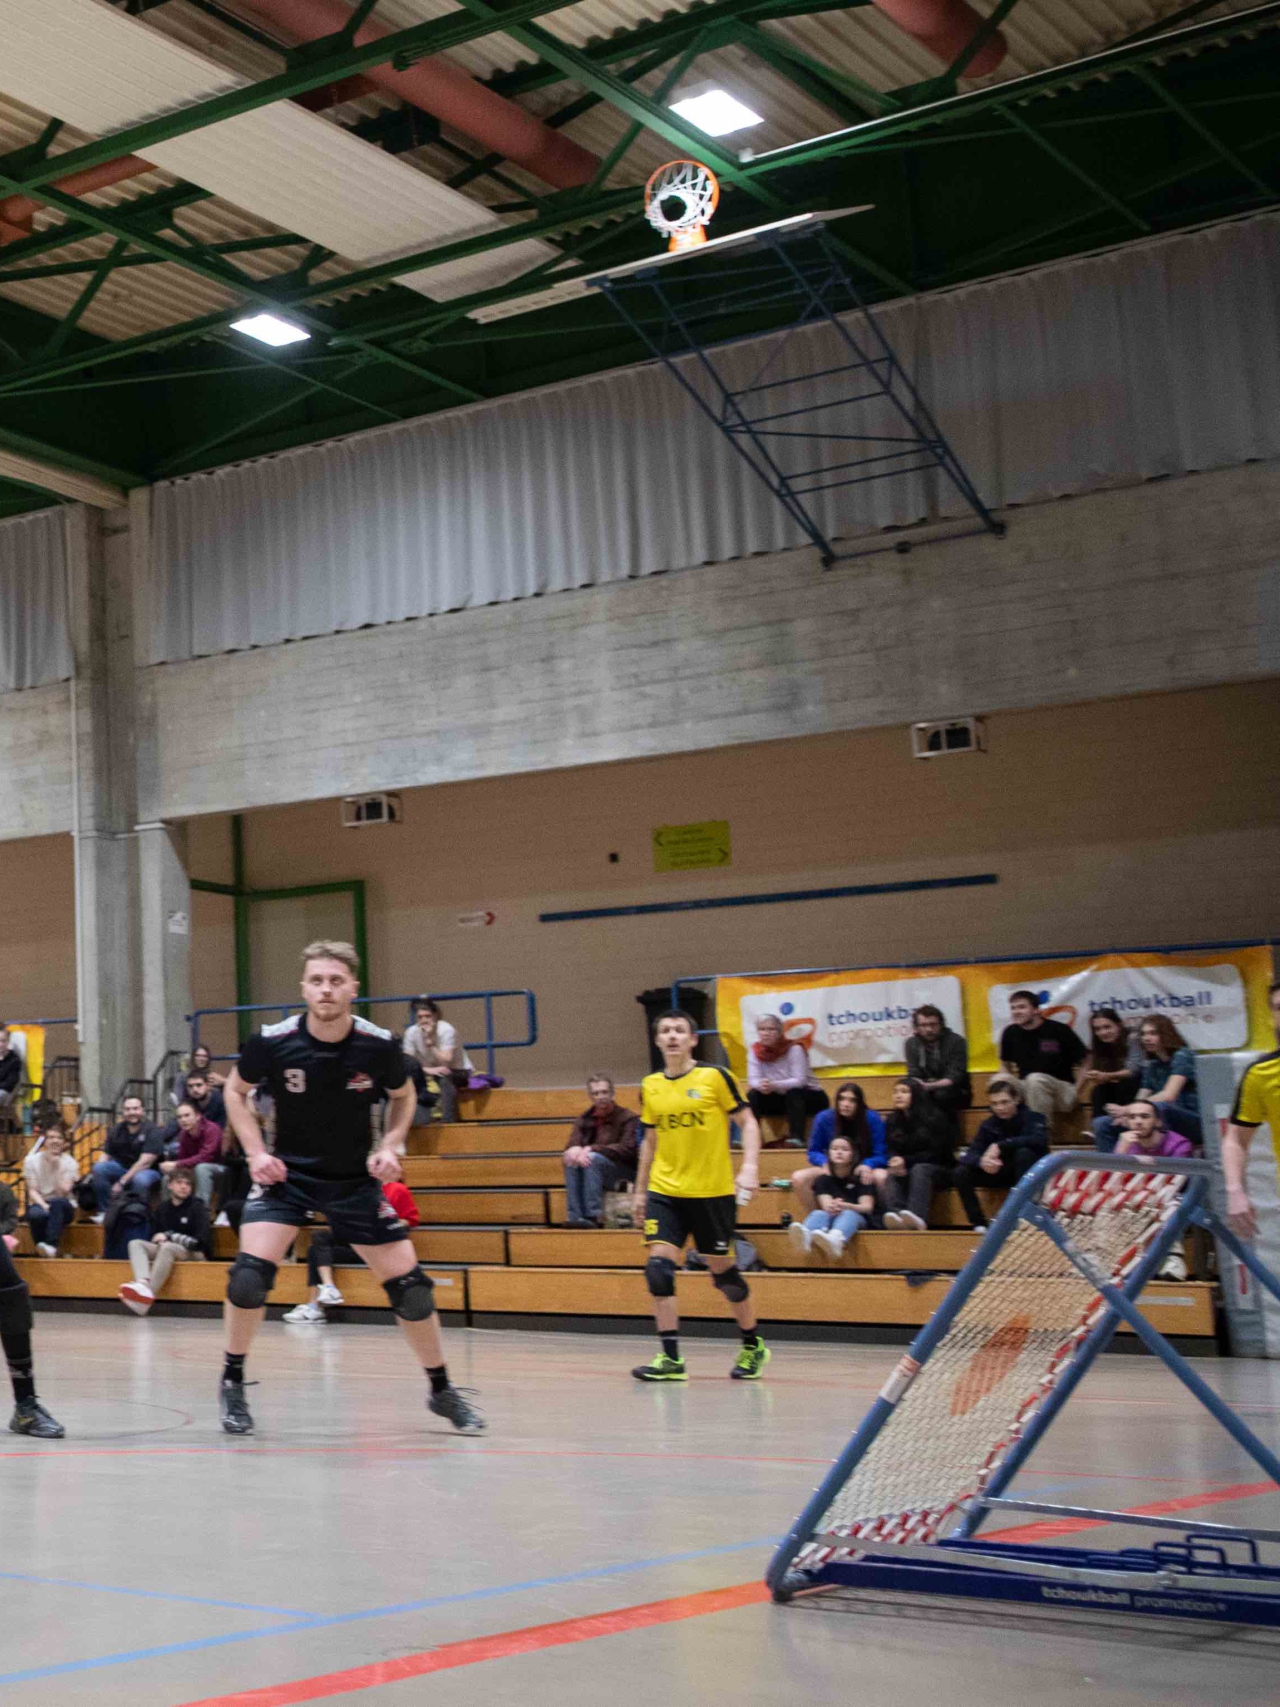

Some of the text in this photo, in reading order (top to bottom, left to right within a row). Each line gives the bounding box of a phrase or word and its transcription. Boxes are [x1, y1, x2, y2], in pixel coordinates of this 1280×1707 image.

[1088, 991, 1213, 1011] tchoukball
[827, 1006, 917, 1026] tchoukb
[283, 1068, 307, 1094] 3
